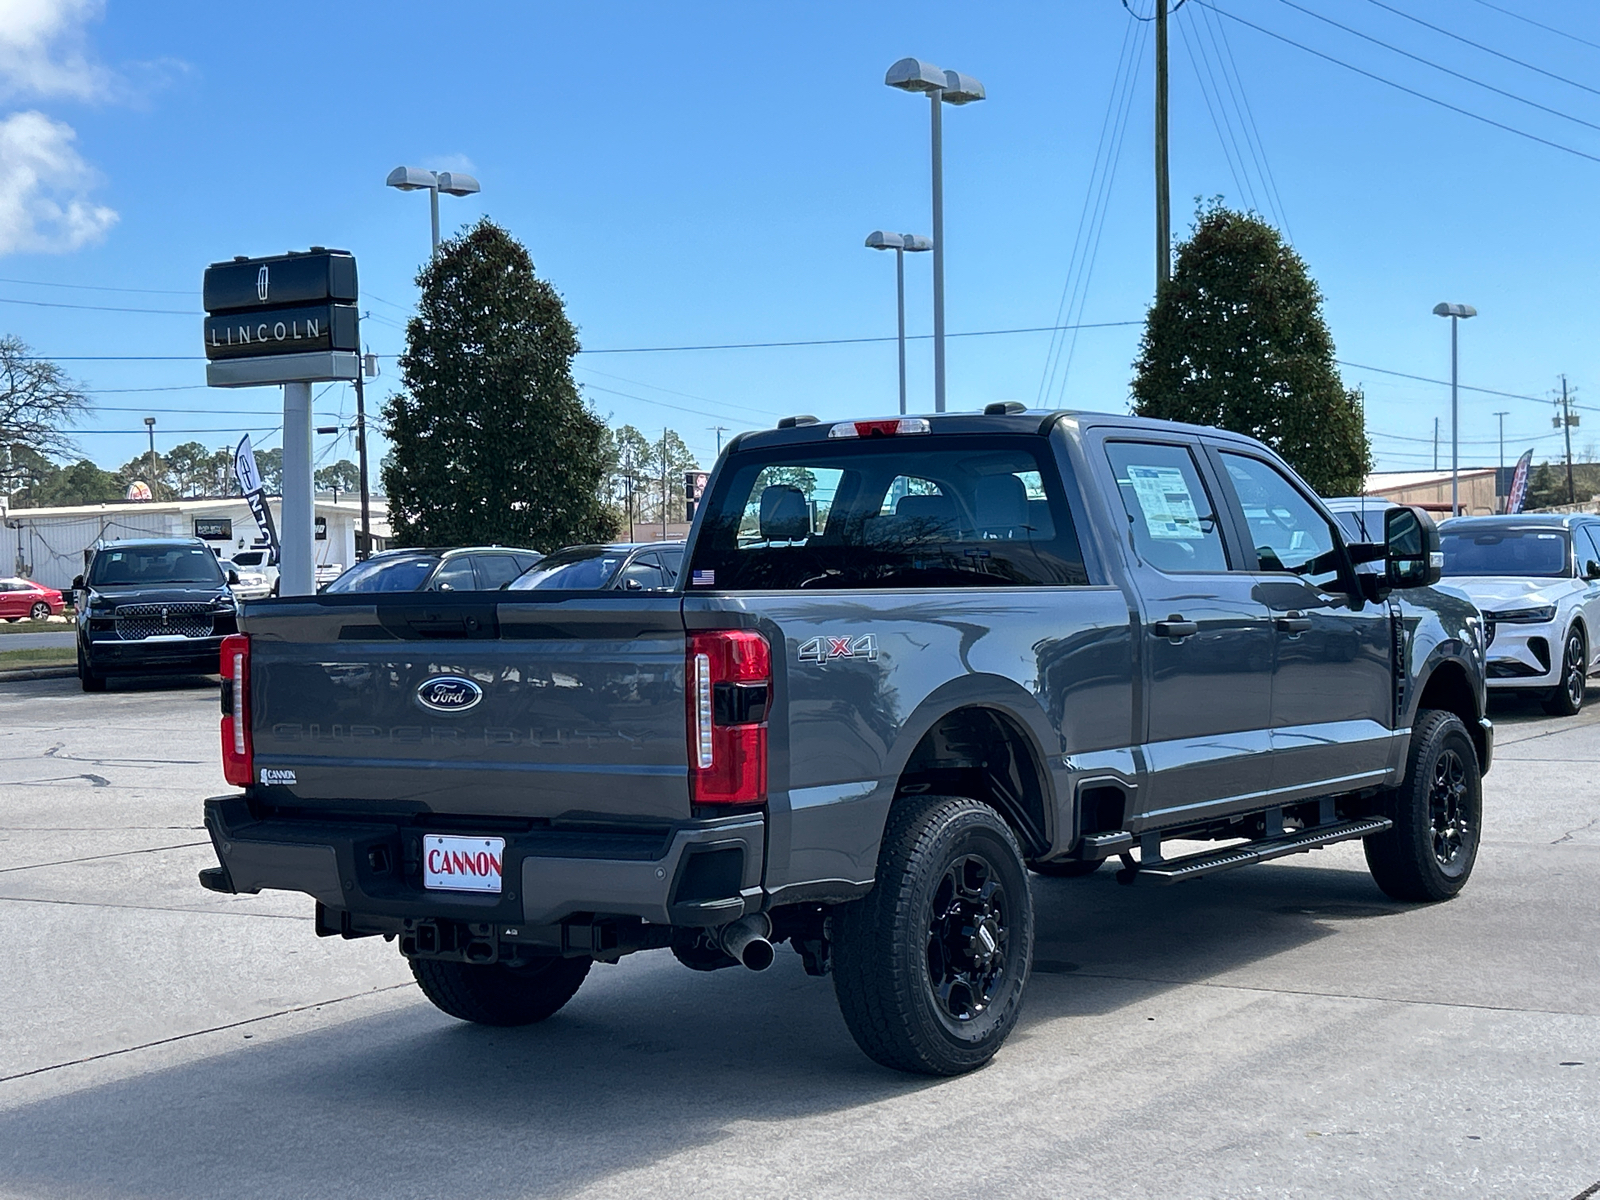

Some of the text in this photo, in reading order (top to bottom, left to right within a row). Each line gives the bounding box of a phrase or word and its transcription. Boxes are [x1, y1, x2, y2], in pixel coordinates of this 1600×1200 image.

[212, 318, 319, 347] LINCOLN
[430, 683, 466, 703] Ford
[272, 722, 656, 750] SUPER DUTY
[267, 769, 296, 779] CANNON
[428, 849, 502, 877] CANNON
